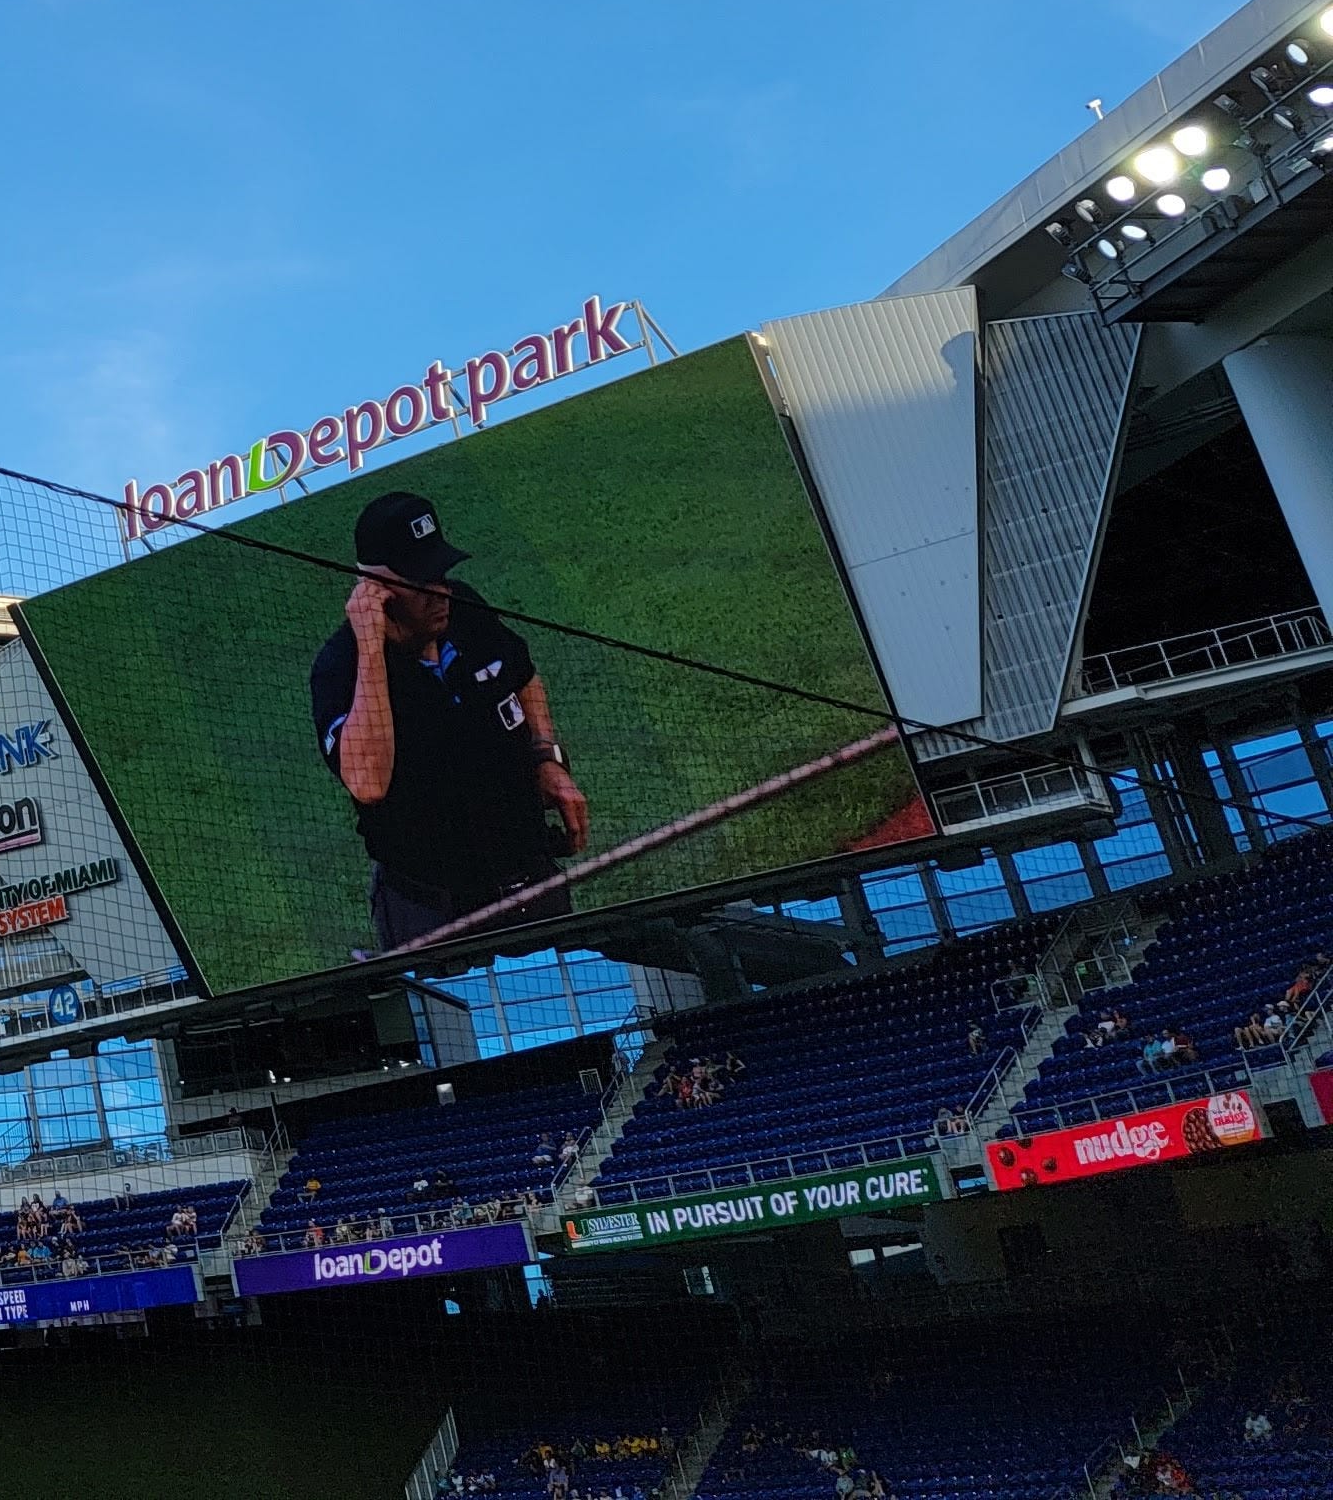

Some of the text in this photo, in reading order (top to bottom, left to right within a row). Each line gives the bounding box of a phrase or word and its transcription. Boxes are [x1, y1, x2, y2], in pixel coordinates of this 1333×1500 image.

[123, 295, 632, 541] loanDepot park
[27, 875, 52, 900] OF
[54, 858, 116, 894] MIAMI
[53, 991, 77, 1018] 42
[1073, 1120, 1171, 1164] nudge
[589, 1212, 640, 1231] SYLVESTER
[646, 1210, 671, 1235] IN
[674, 1195, 764, 1231] PURSUIT
[770, 1190, 799, 1217] OF
[803, 1180, 861, 1212] YOUR
[314, 1238, 443, 1281] loanDepot
[4, 1304, 28, 1319] TYPE
[70, 1300, 90, 1312] MPH
